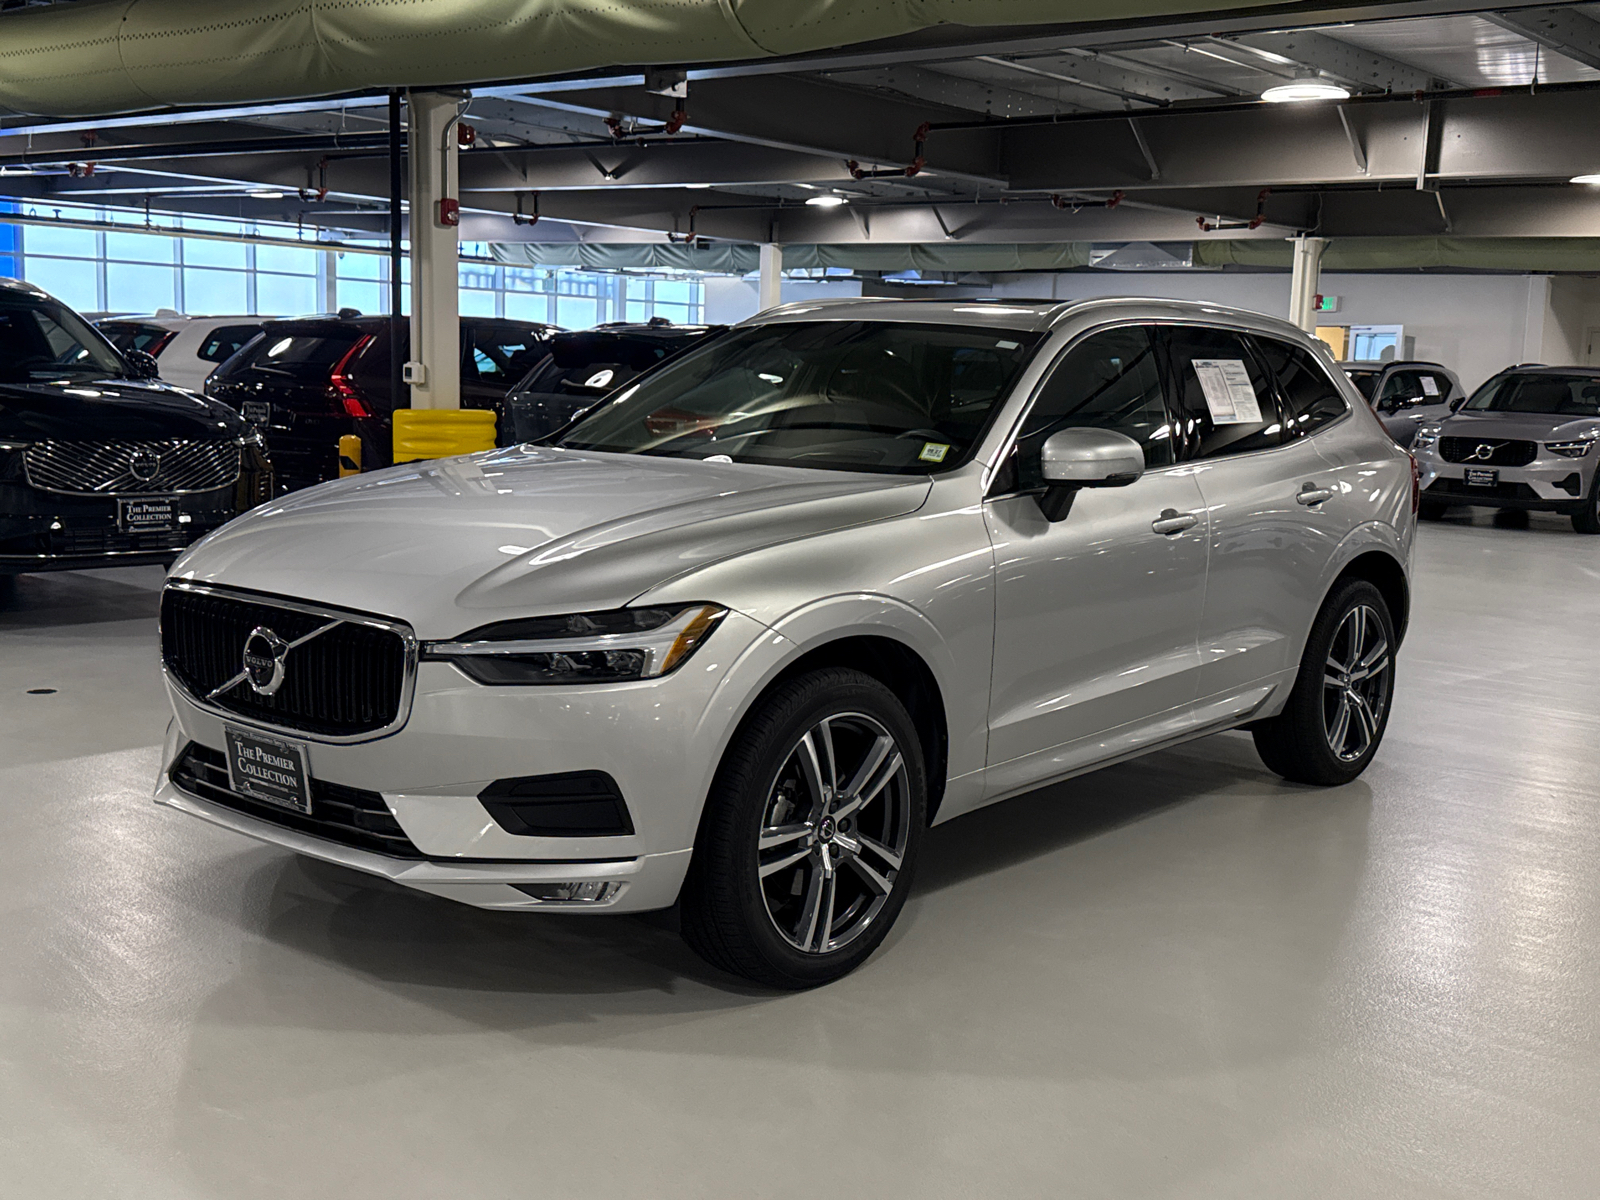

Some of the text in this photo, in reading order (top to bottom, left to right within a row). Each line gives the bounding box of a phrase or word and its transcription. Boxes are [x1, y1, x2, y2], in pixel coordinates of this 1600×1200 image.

[126, 504, 171, 513] THE PREMIER
[126, 513, 172, 521] COLLECTION
[245, 655, 273, 668] VOLVO
[235, 741, 296, 772] THE PREMIER
[237, 757, 298, 788] COLLECTION
